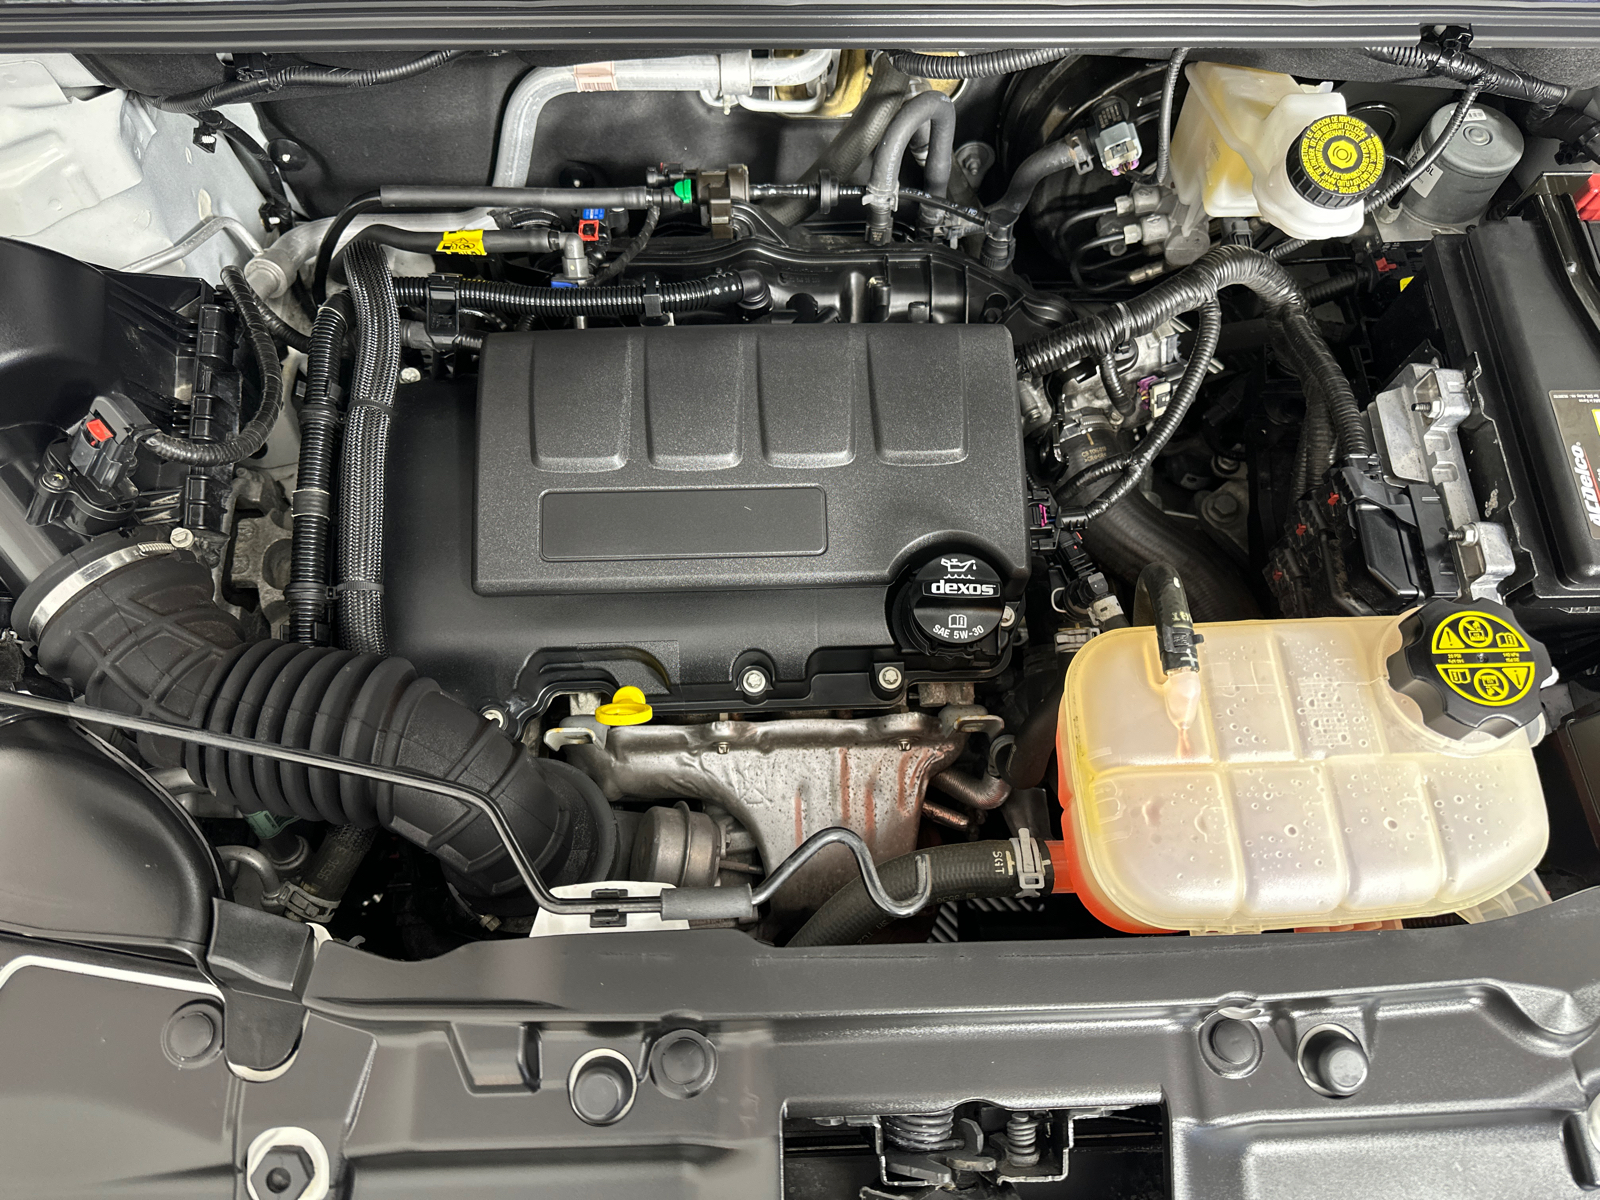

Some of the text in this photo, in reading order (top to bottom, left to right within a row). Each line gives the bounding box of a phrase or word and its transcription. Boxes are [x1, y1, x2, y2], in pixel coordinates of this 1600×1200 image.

[1314, 167, 1323, 176] DE
[1359, 181, 1370, 191] CAP
[931, 579, 995, 596] dexos
[932, 624, 985, 640] SAE 5W-30
[316, 859, 340, 881] 9536
[992, 850, 1005, 875] SGT
